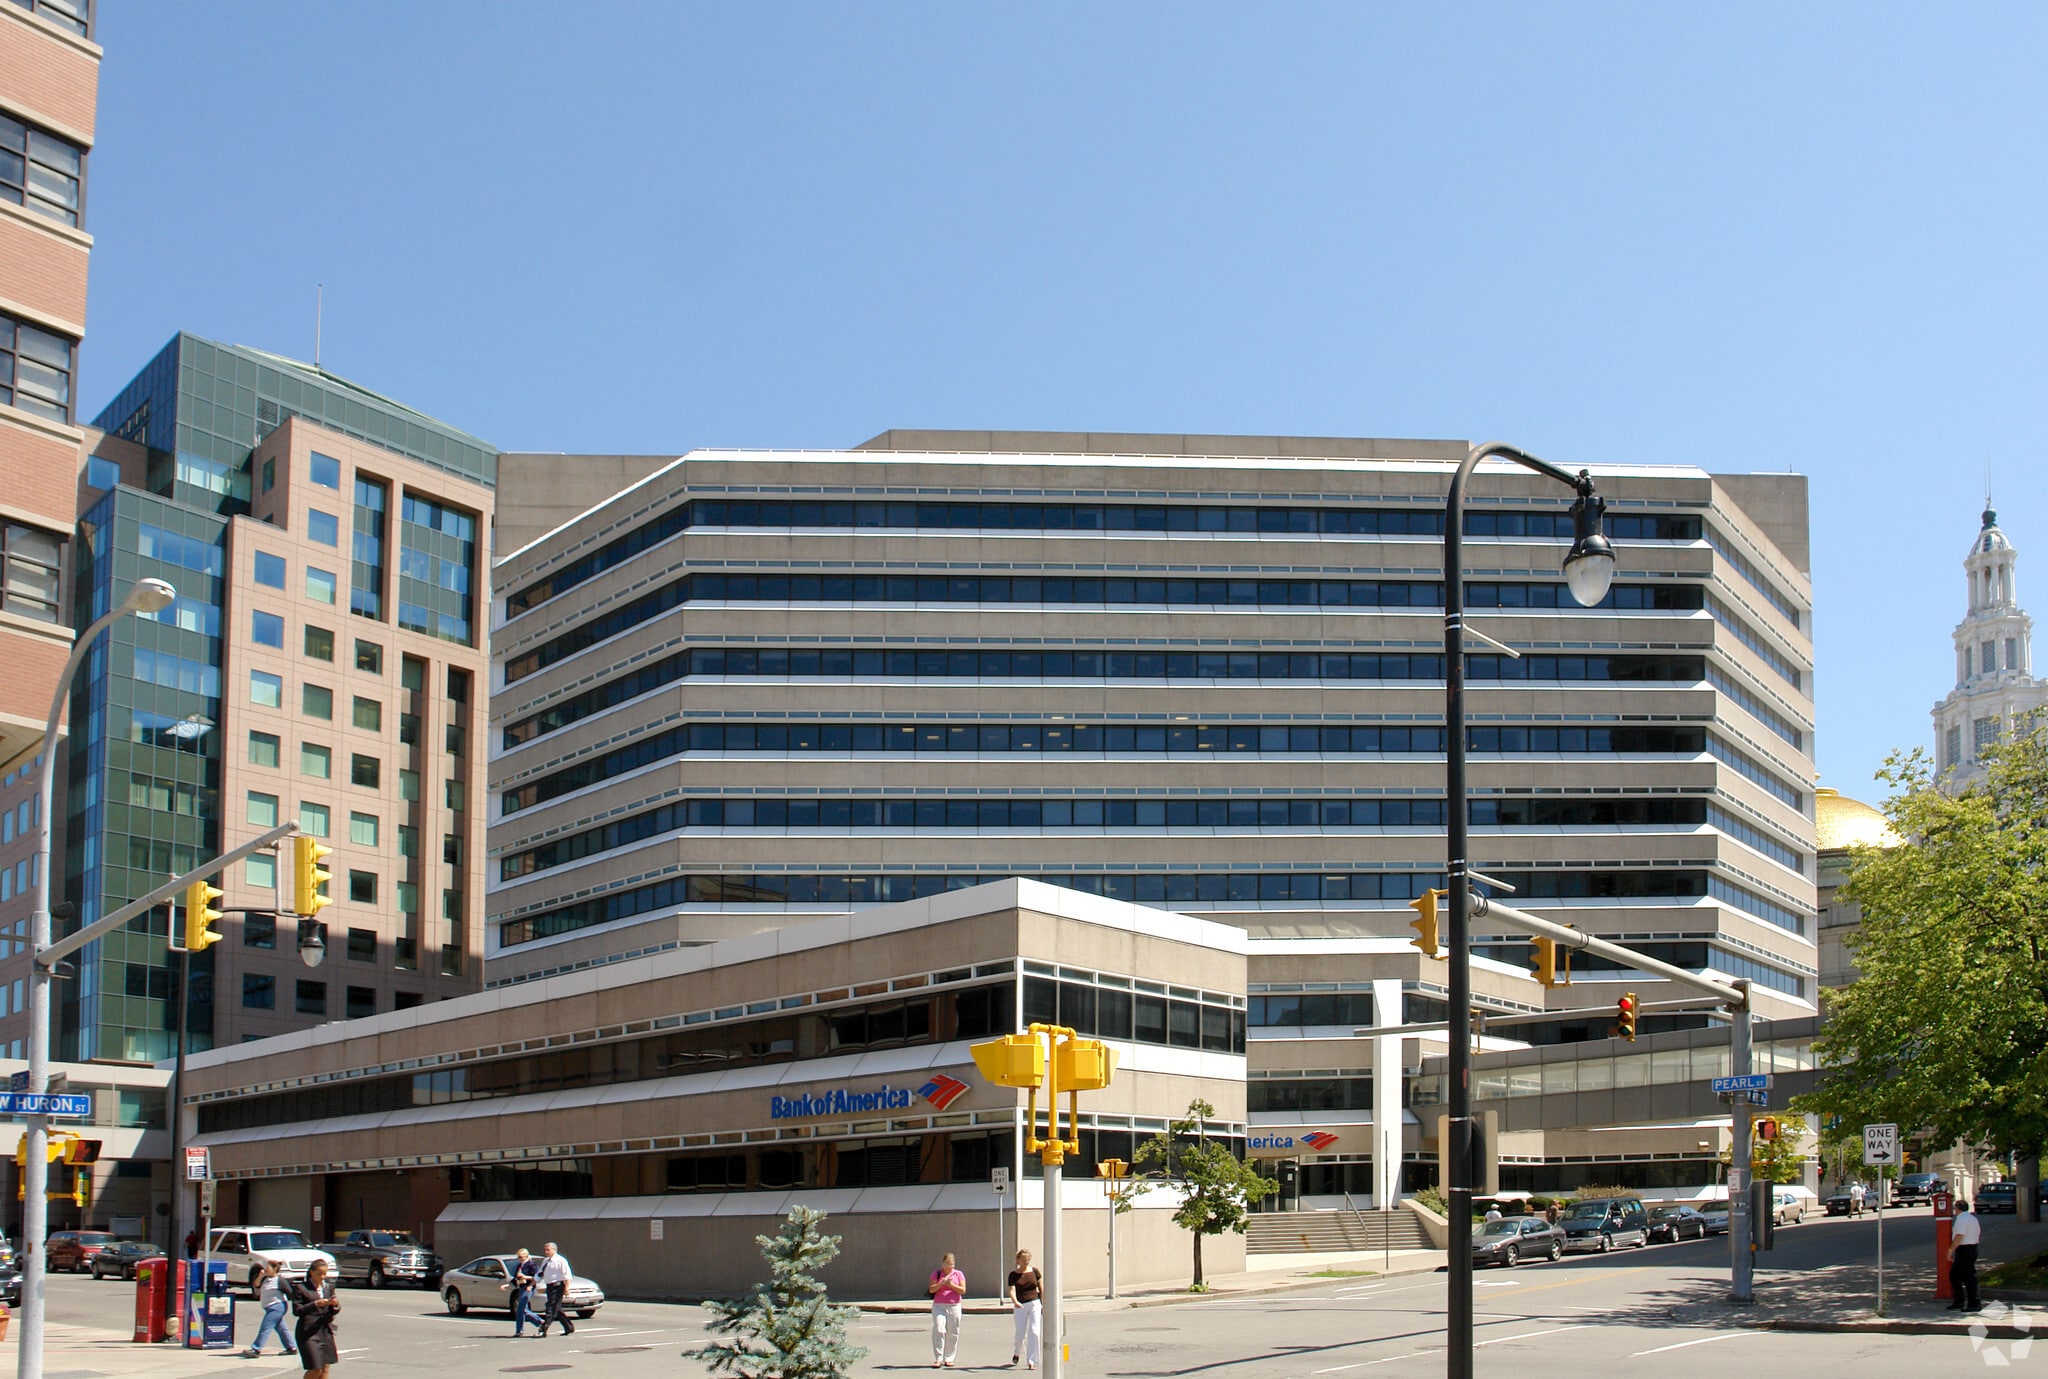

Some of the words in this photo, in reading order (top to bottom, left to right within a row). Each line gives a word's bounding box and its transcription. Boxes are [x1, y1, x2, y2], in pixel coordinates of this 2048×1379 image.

[1715, 1078, 1754, 1090] PEARL
[15, 1096, 73, 1112] HURON
[75, 1104, 87, 1113] ST
[771, 1093, 815, 1119] Bank
[815, 1090, 834, 1115] of
[833, 1085, 913, 1113] America
[1868, 1128, 1892, 1138] ONE
[1247, 1133, 1293, 1148] erica
[1867, 1140, 1892, 1149] WAY
